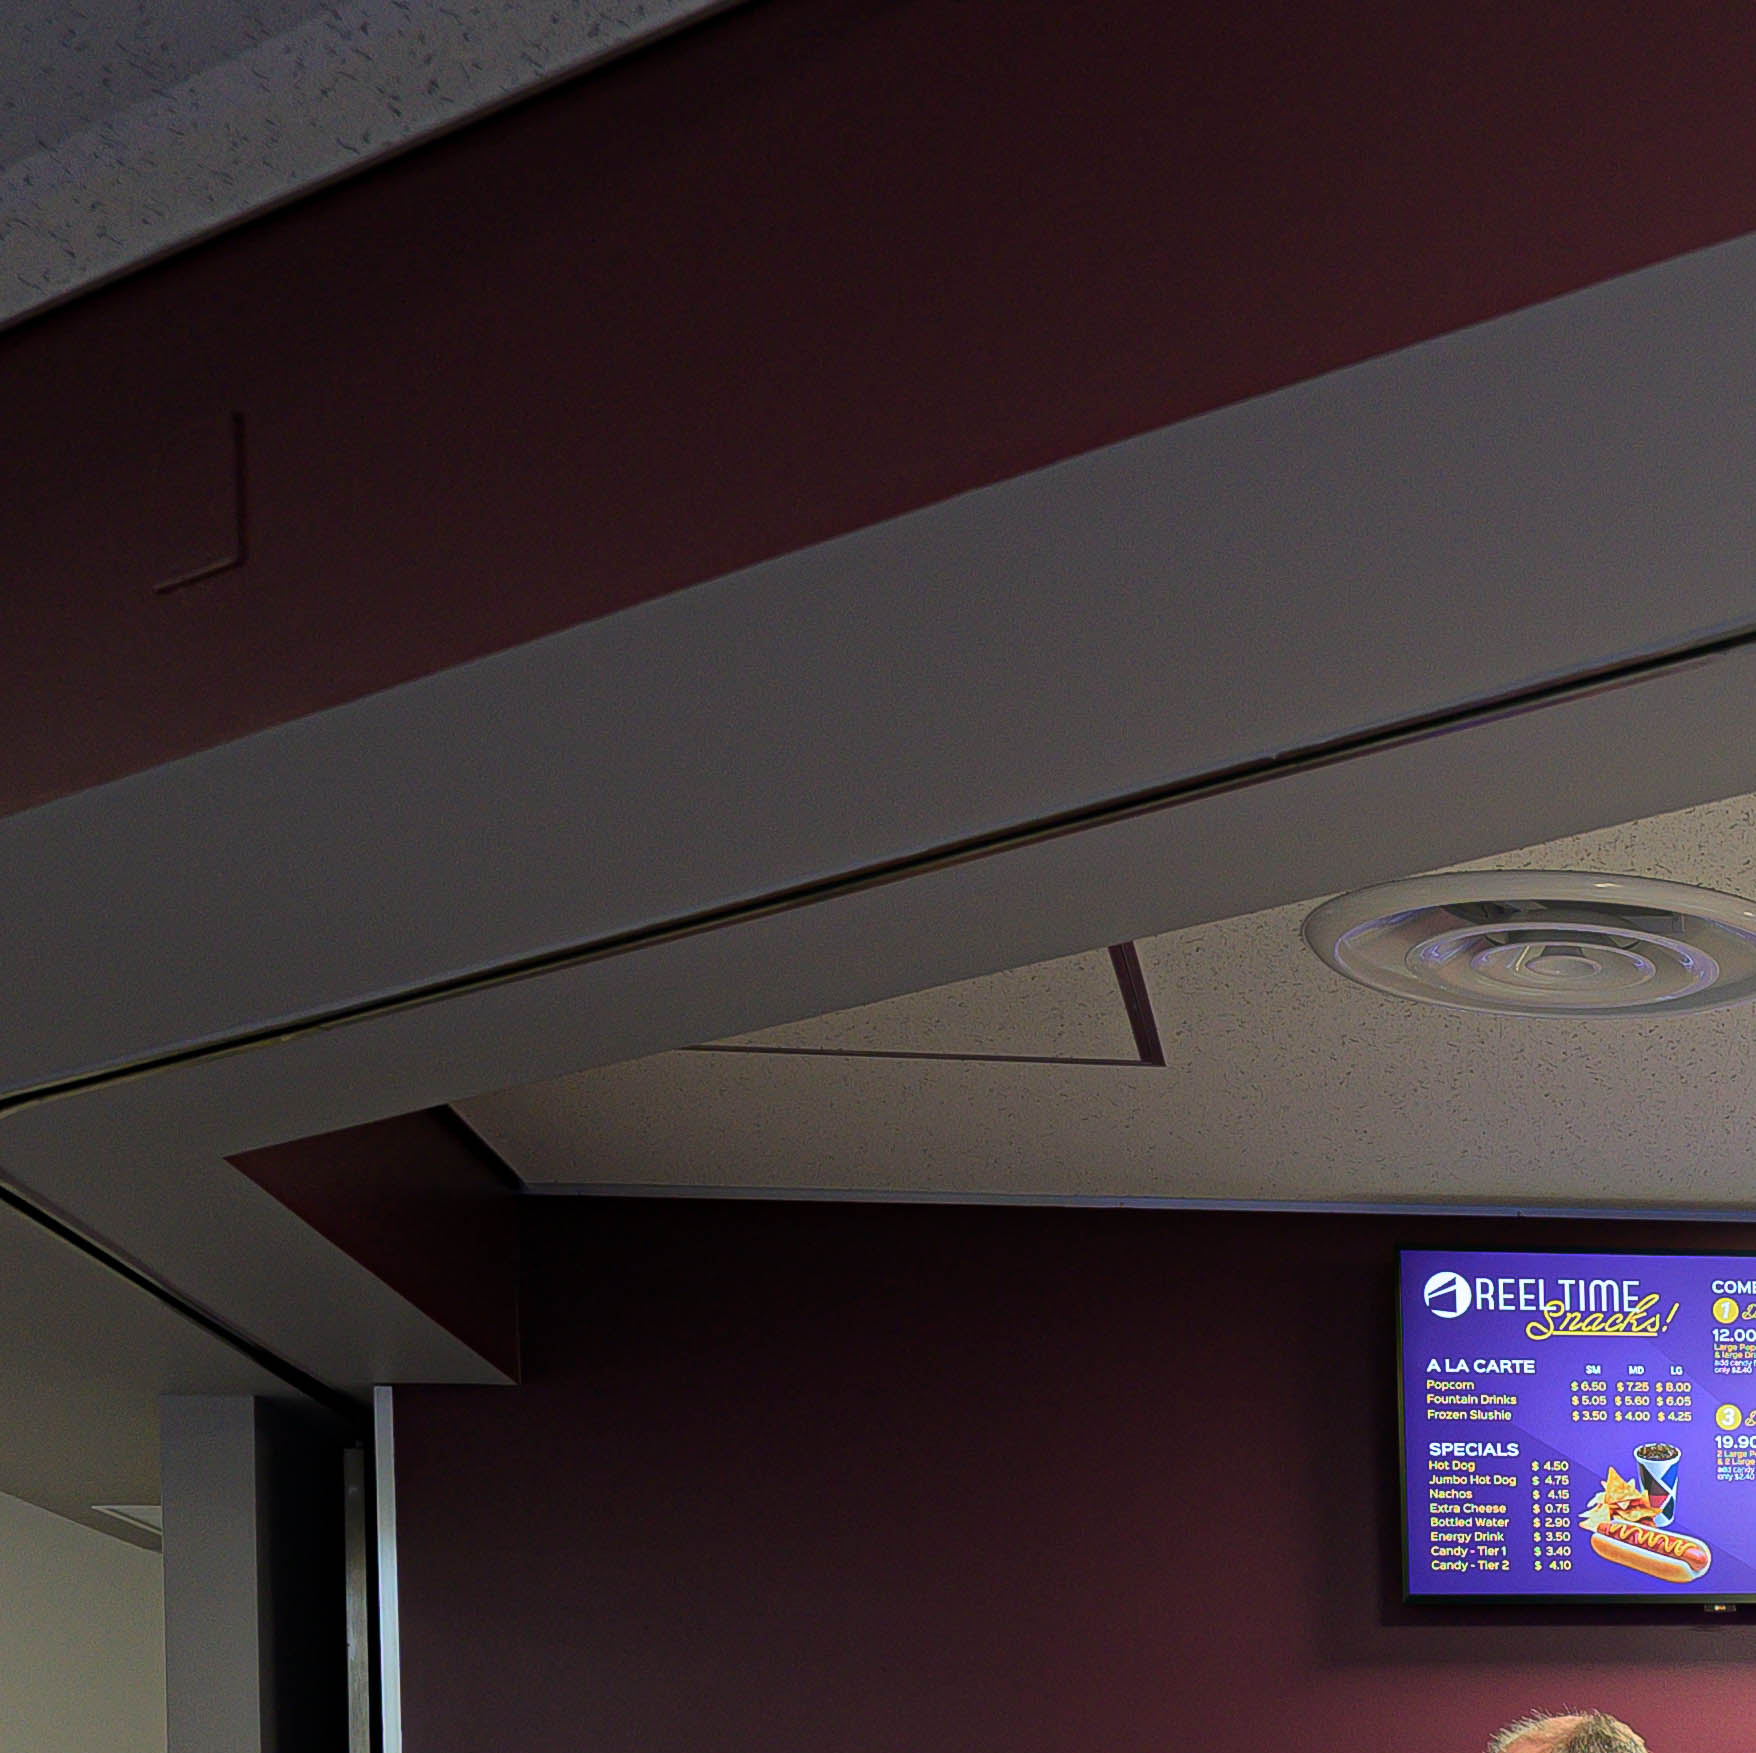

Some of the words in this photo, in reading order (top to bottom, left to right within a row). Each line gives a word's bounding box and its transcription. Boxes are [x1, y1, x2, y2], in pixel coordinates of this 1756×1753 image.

[1525, 1293, 1680, 1340] Snacks!
[1720, 1302, 1731, 1320] 1
[1712, 1329, 1756, 1342] 12.00
[1426, 1359, 1441, 1374] A
[1445, 1360, 1469, 1374] LA
[1474, 1360, 1536, 1374] CARTE
[1427, 1394, 1478, 1405] Fountain
[1481, 1394, 1517, 1405] Drinks
[1427, 1410, 1468, 1420] Frozen
[1722, 1408, 1735, 1427] 3
[1429, 1442, 1520, 1457] SPECIALS
[1428, 1460, 1450, 1471] Hot
[1452, 1461, 1475, 1473] Dog
[1429, 1475, 1467, 1486] Jumbo
[1470, 1475, 1491, 1486] Hot
[1493, 1475, 1517, 1488] Dog
[1429, 1489, 1472, 1499] Nachos
[1430, 1503, 1460, 1514] Extra
[1463, 1503, 1507, 1514] Cheese
[1430, 1517, 1472, 1528] Bottled
[1474, 1517, 1510, 1528] Water
[1430, 1531, 1471, 1544] Energy
[1474, 1531, 1505, 1542] Drink
[1430, 1545, 1468, 1558] Candy
[1477, 1545, 1499, 1556] Tier
[1501, 1545, 1507, 1556] 1
[1431, 1559, 1468, 1572] Candy
[1477, 1560, 1499, 1571] Tier
[1501, 1560, 1510, 1571] 2
